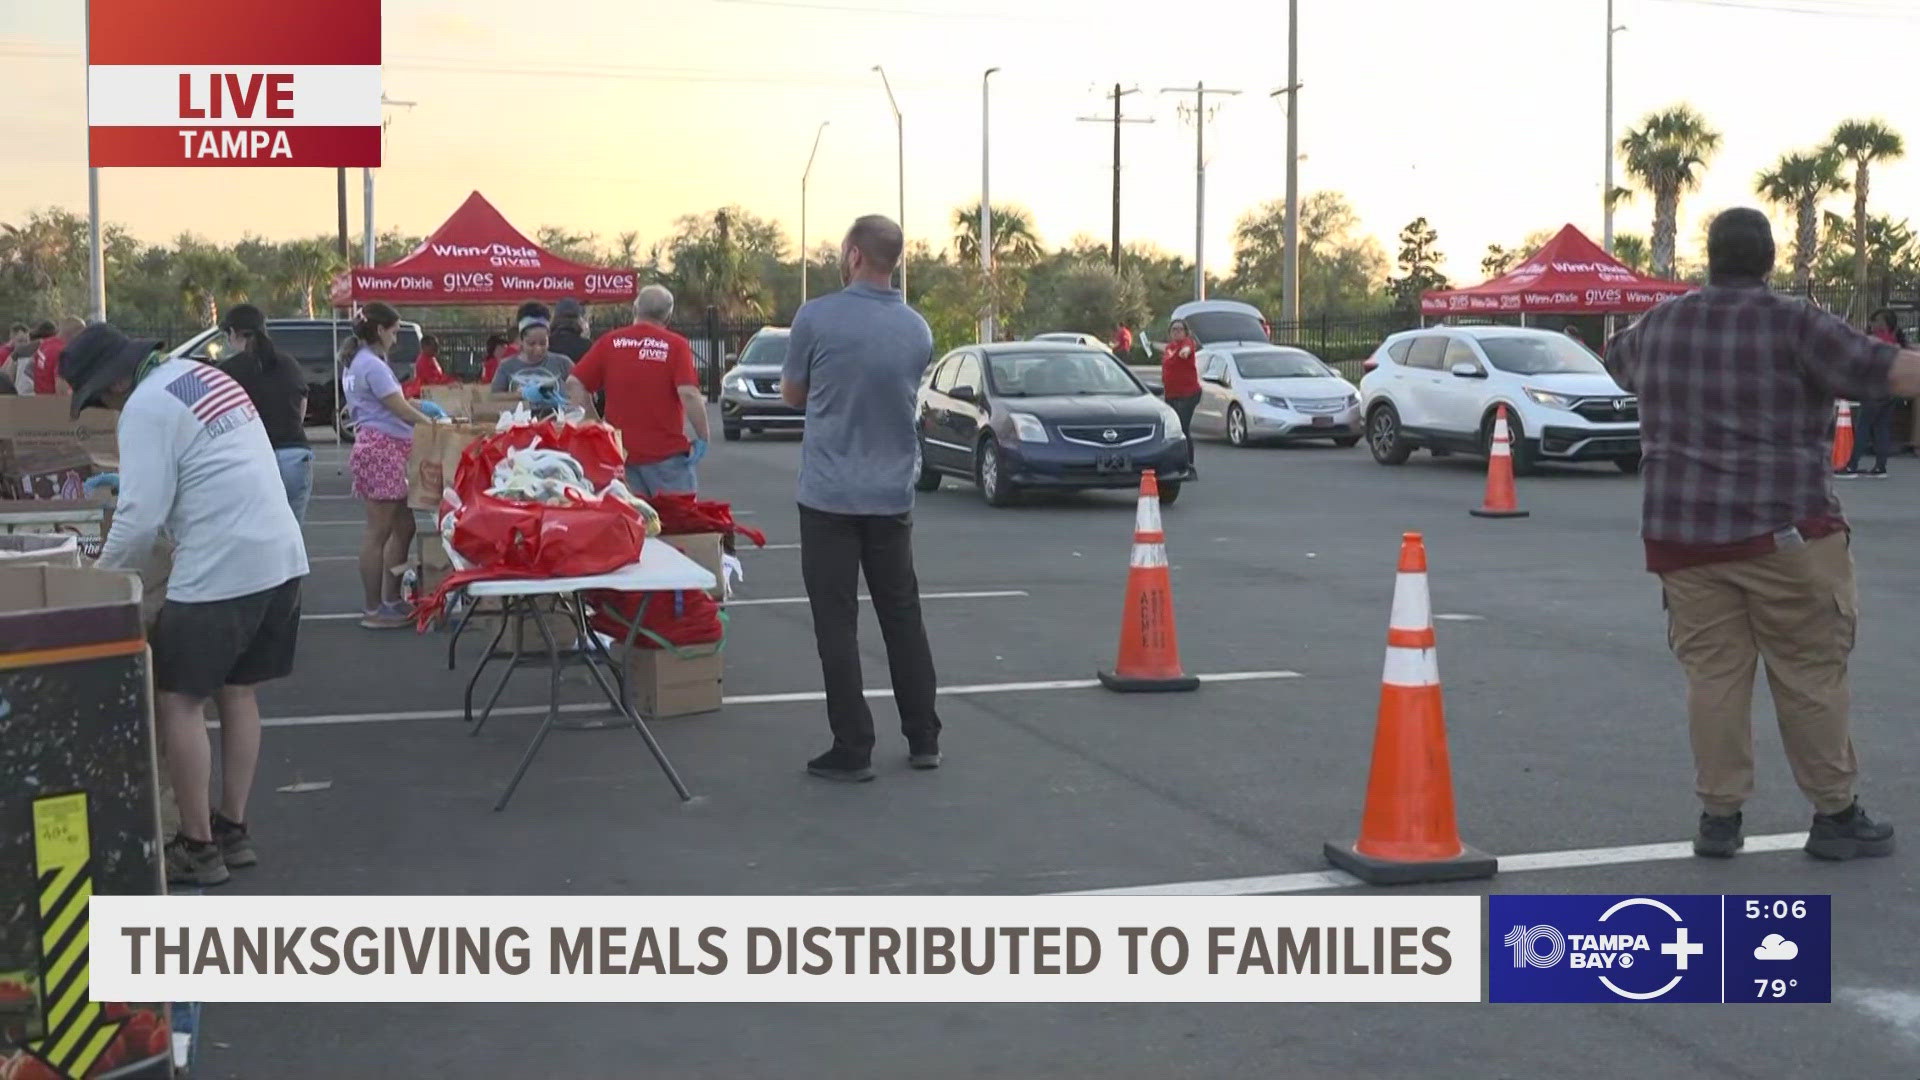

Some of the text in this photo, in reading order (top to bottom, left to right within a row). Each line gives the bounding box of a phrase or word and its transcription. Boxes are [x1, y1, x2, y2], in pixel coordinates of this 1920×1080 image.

[443, 272, 494, 292] gives
[585, 274, 633, 294] gives
[1585, 289, 1621, 305] gives
